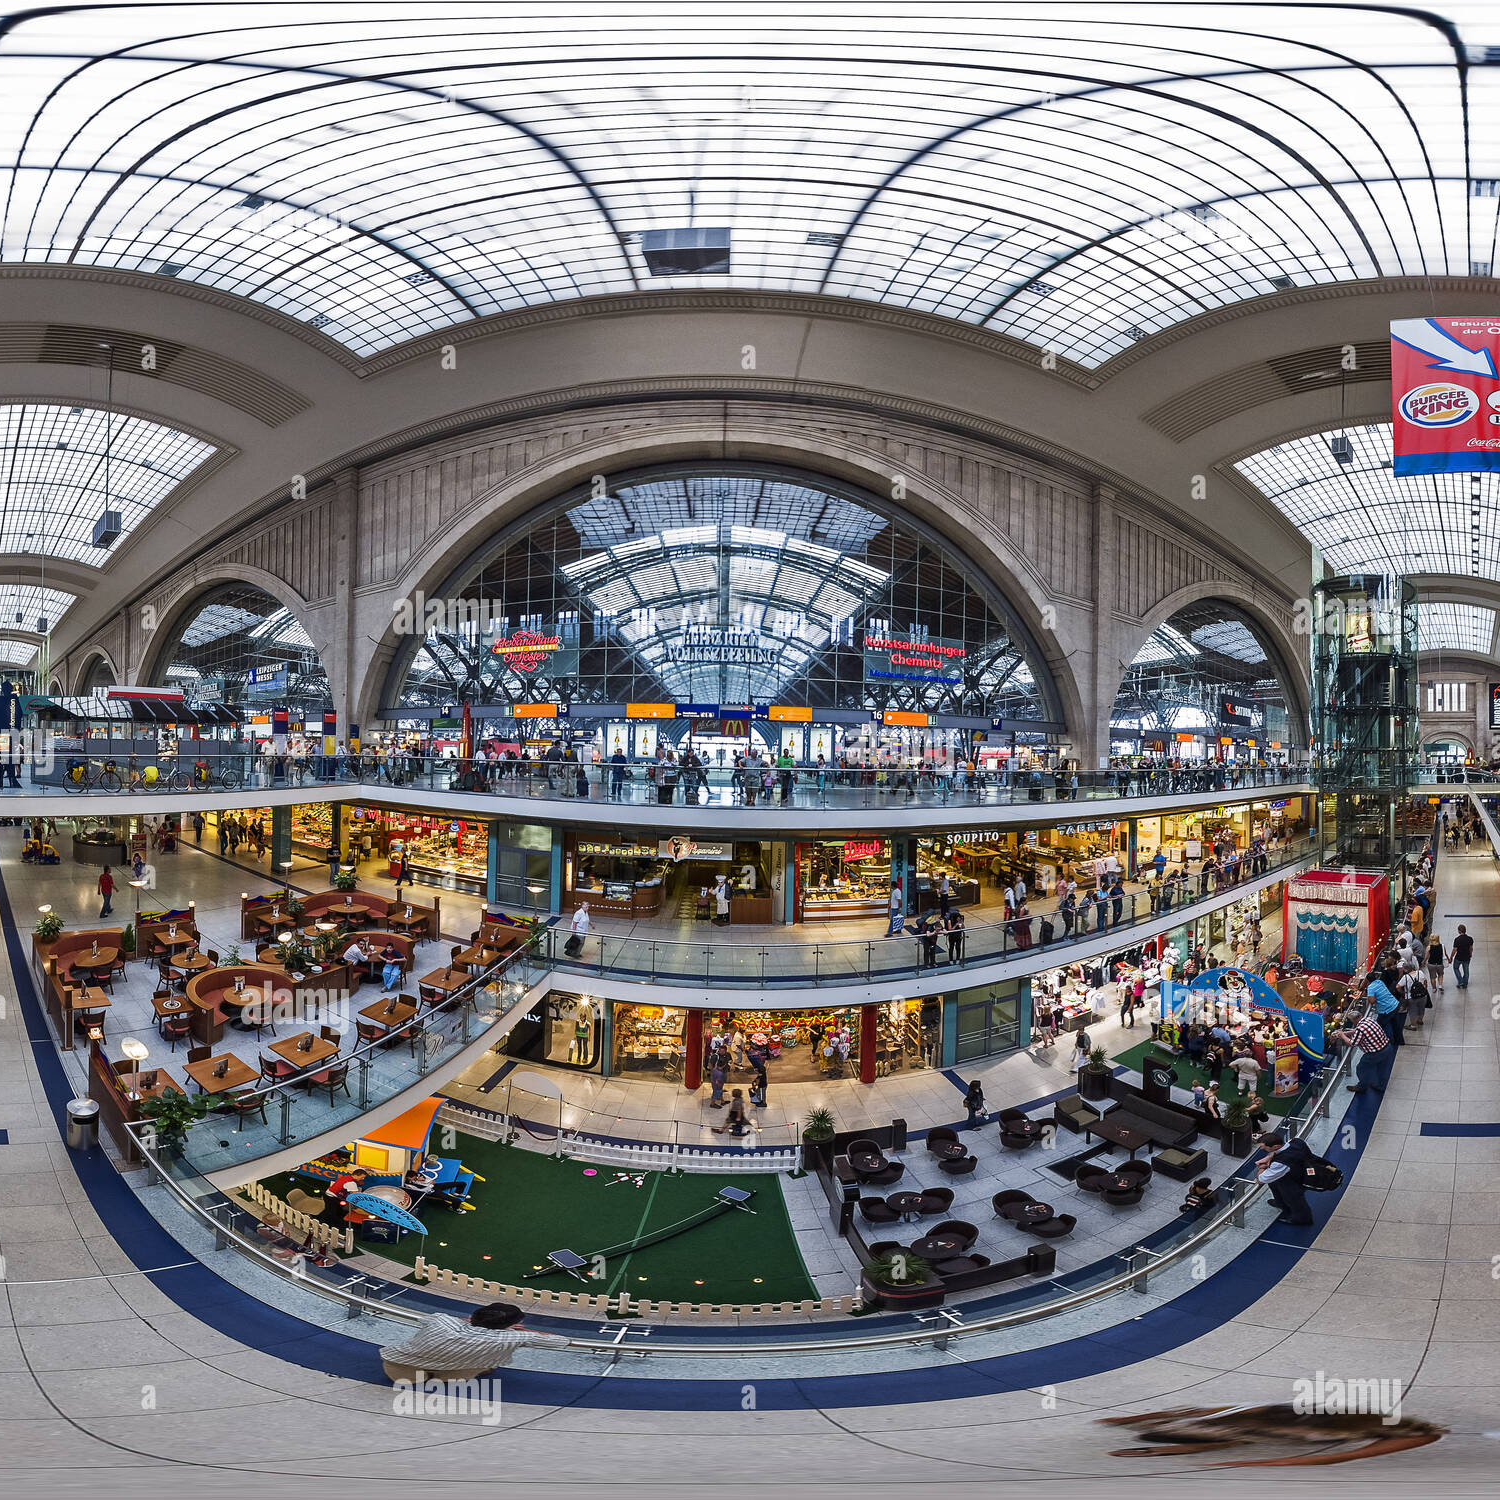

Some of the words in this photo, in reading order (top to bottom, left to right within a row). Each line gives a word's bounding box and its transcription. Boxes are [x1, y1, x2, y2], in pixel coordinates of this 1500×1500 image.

[1409, 390, 1467, 409] BURGER
[1412, 398, 1470, 420] KING
[865, 635, 966, 657] Kunstsammlungen
[891, 653, 943, 669] Chemnitz
[256, 672, 274, 682] MESSE
[441, 707, 449, 715] 14
[559, 704, 568, 713] 15
[872, 710, 883, 720] 16
[993, 718, 999, 726] 17
[366, 808, 397, 823] Wiener
[947, 831, 999, 844] SOUPITO
[523, 1013, 542, 1023] NLY.
[732, 1014, 837, 1029] NANU-NANA
